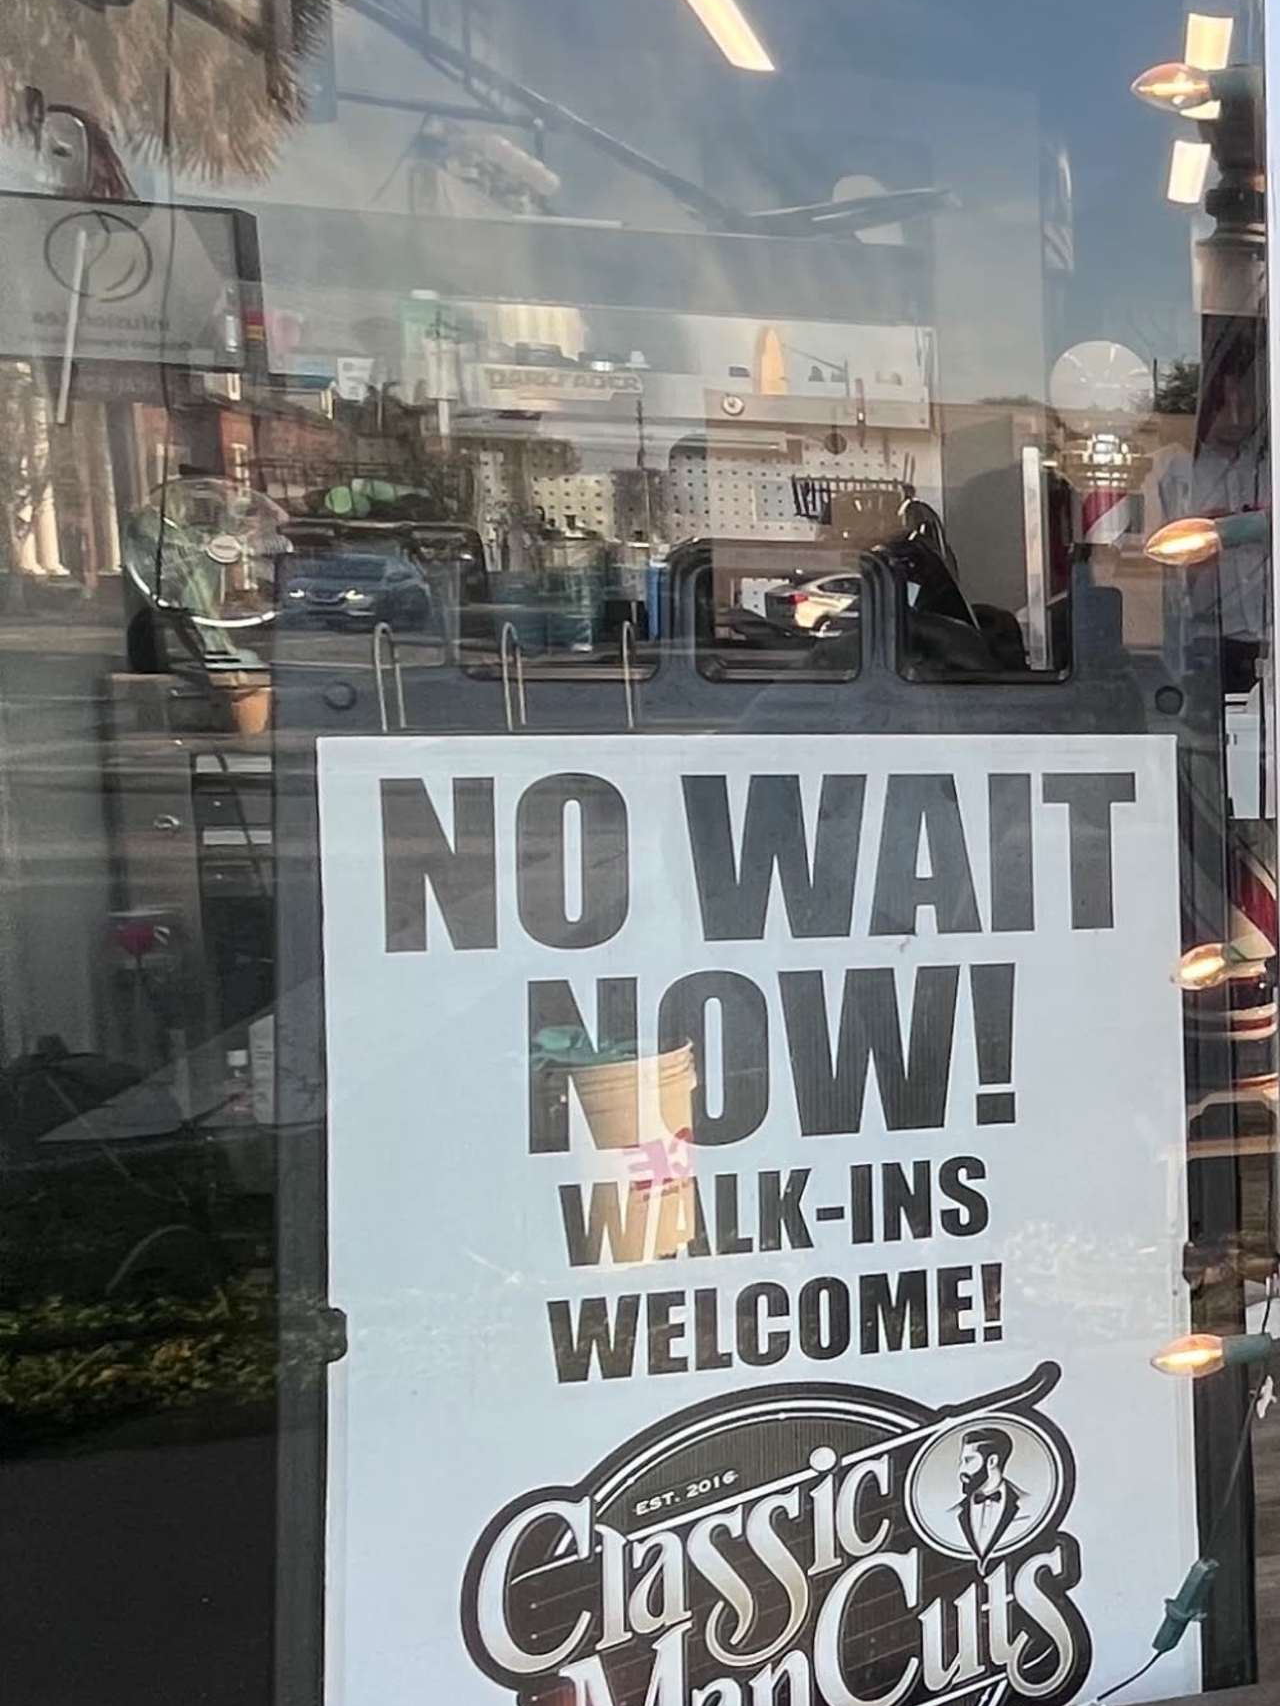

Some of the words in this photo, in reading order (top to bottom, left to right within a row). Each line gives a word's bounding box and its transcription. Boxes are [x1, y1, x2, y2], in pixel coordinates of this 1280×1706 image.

[379, 773, 628, 953] NO
[681, 771, 1137, 943] WAIT
[527, 962, 1018, 1154] NOW!
[559, 1155, 990, 1268] WALK-INS
[546, 1262, 1005, 1383] WELCOME!
[478, 1446, 892, 1675] Classic
[635, 1491, 681, 1517] EST.
[686, 1469, 739, 1499] 2016
